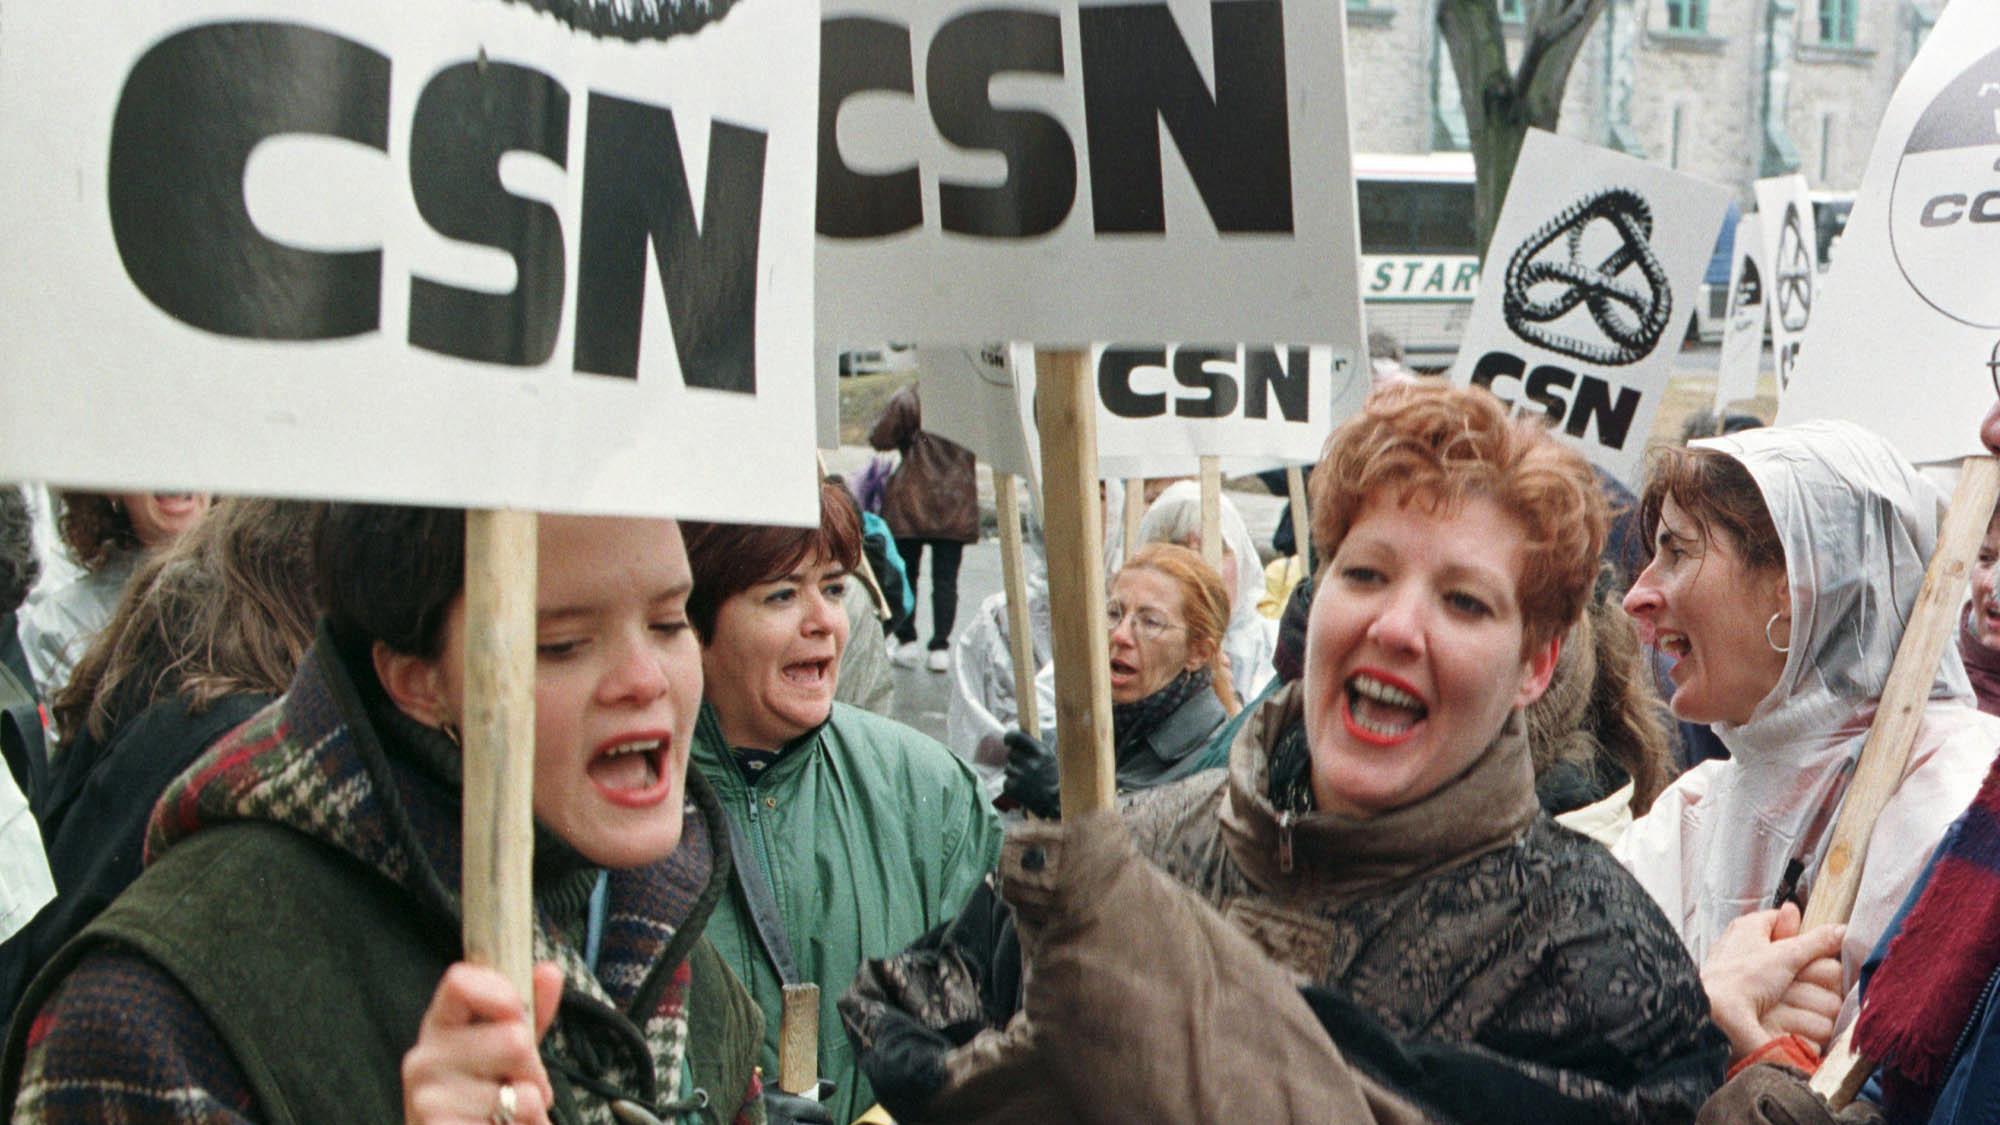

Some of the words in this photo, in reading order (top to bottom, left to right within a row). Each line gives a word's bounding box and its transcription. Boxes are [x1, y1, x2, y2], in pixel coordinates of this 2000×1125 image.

[815, 0, 1295, 240] CSN
[107, 20, 769, 397] CSN
[1370, 261, 1479, 292] STAR
[1098, 344, 1310, 423] CSN
[1470, 351, 1642, 451] CSN
